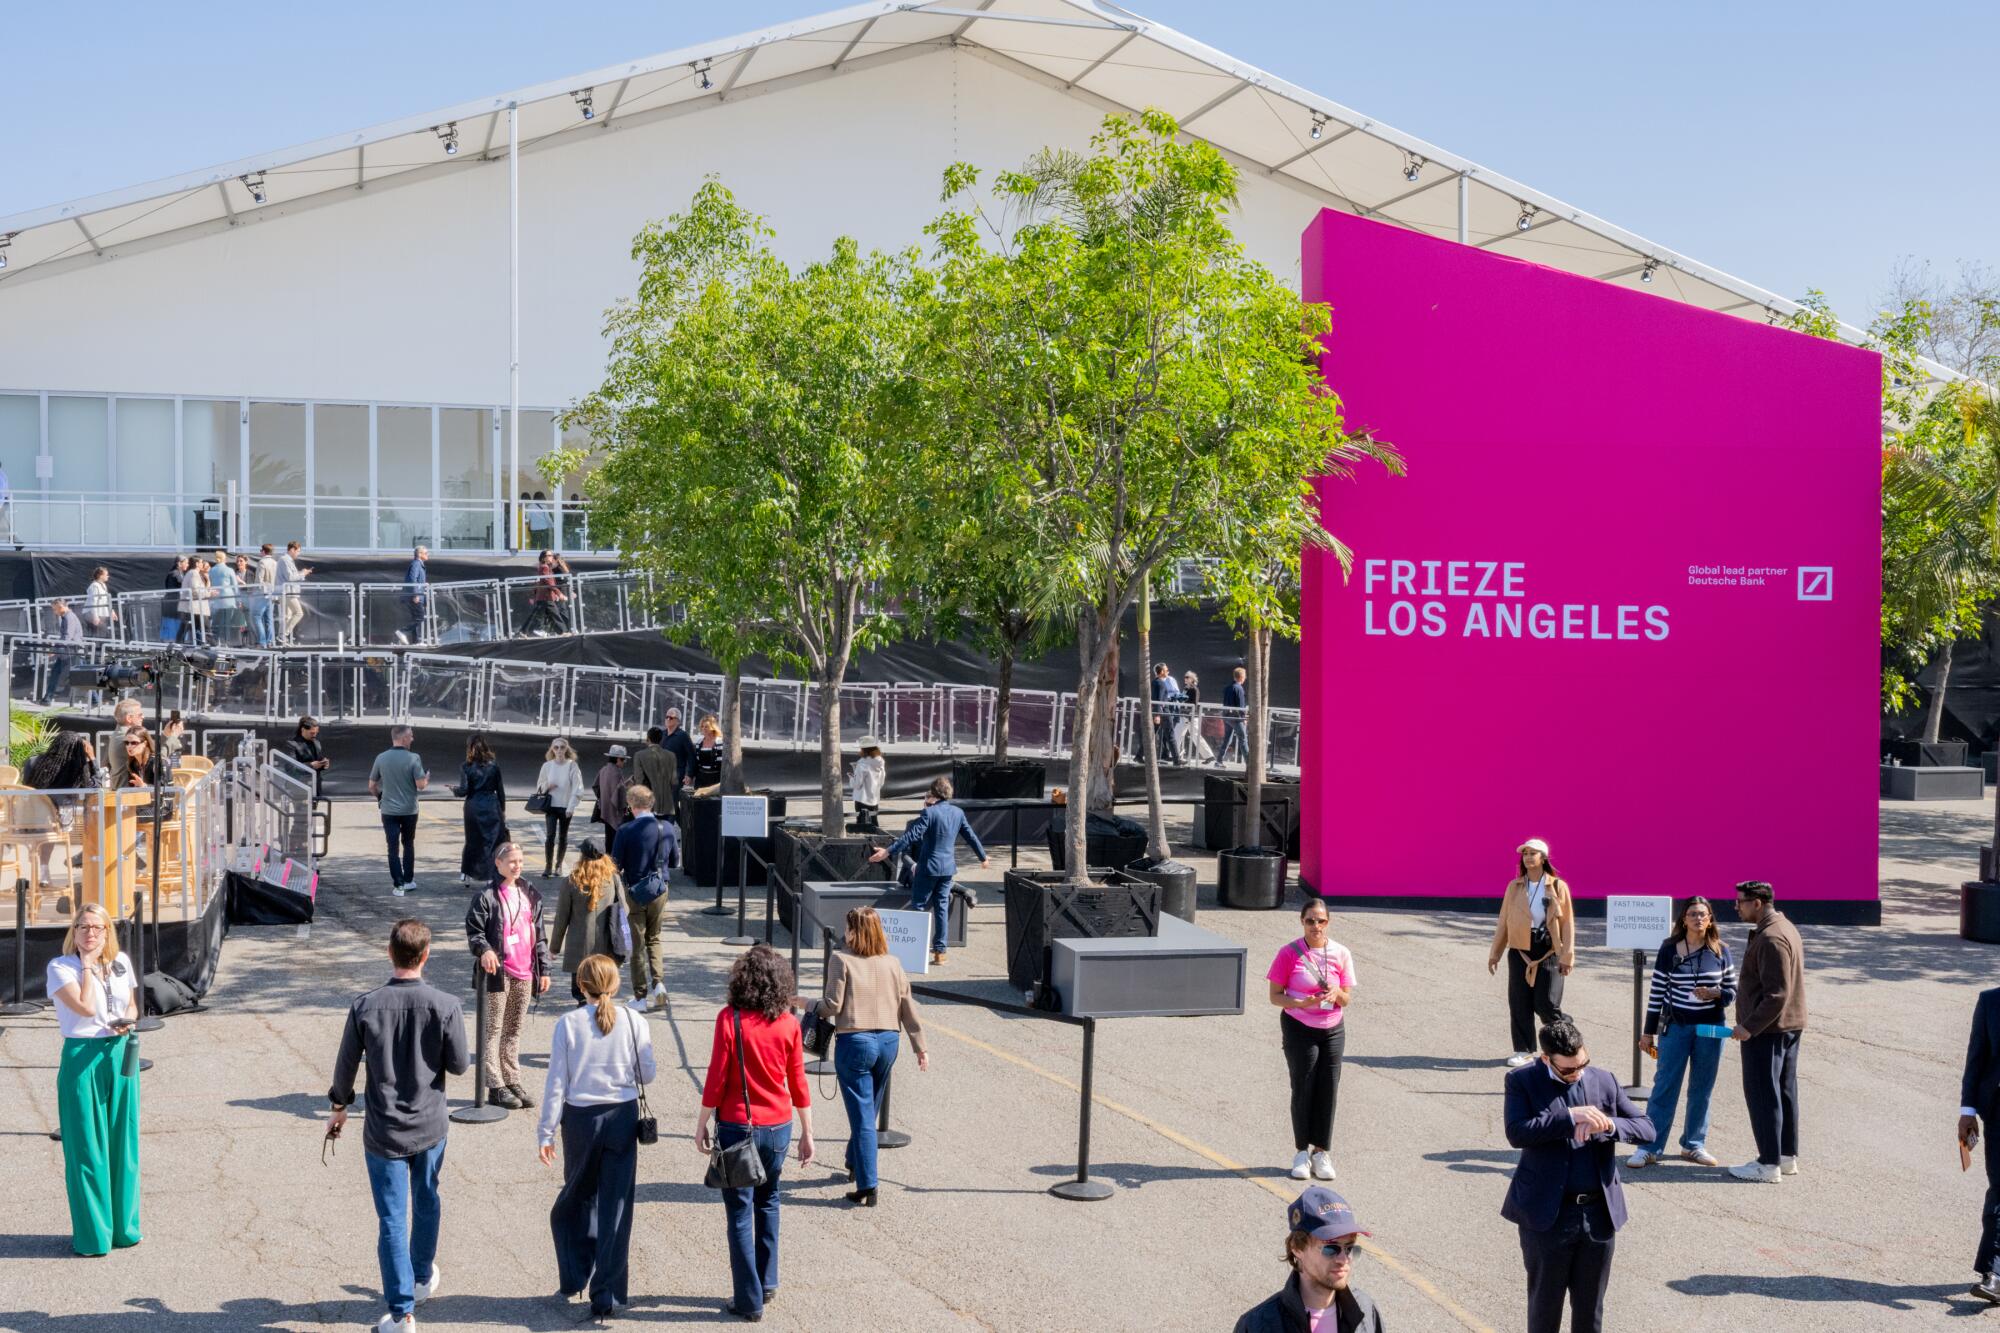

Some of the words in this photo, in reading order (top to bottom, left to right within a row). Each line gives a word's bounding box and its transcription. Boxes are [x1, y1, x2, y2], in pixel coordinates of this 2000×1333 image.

[1688, 565, 1720, 575] Global
[1723, 565, 1745, 575] lead
[1747, 566, 1788, 577] partner
[1364, 559, 1526, 597] FRIEZE
[1688, 576, 1737, 585] Deutsche
[1740, 576, 1766, 586] Bank
[1365, 600, 1447, 637] LOS
[1462, 602, 1670, 641] ANGELES
[888, 917, 899, 925] TO
[883, 926, 909, 935] NLOAD
[901, 936, 917, 944] APP
